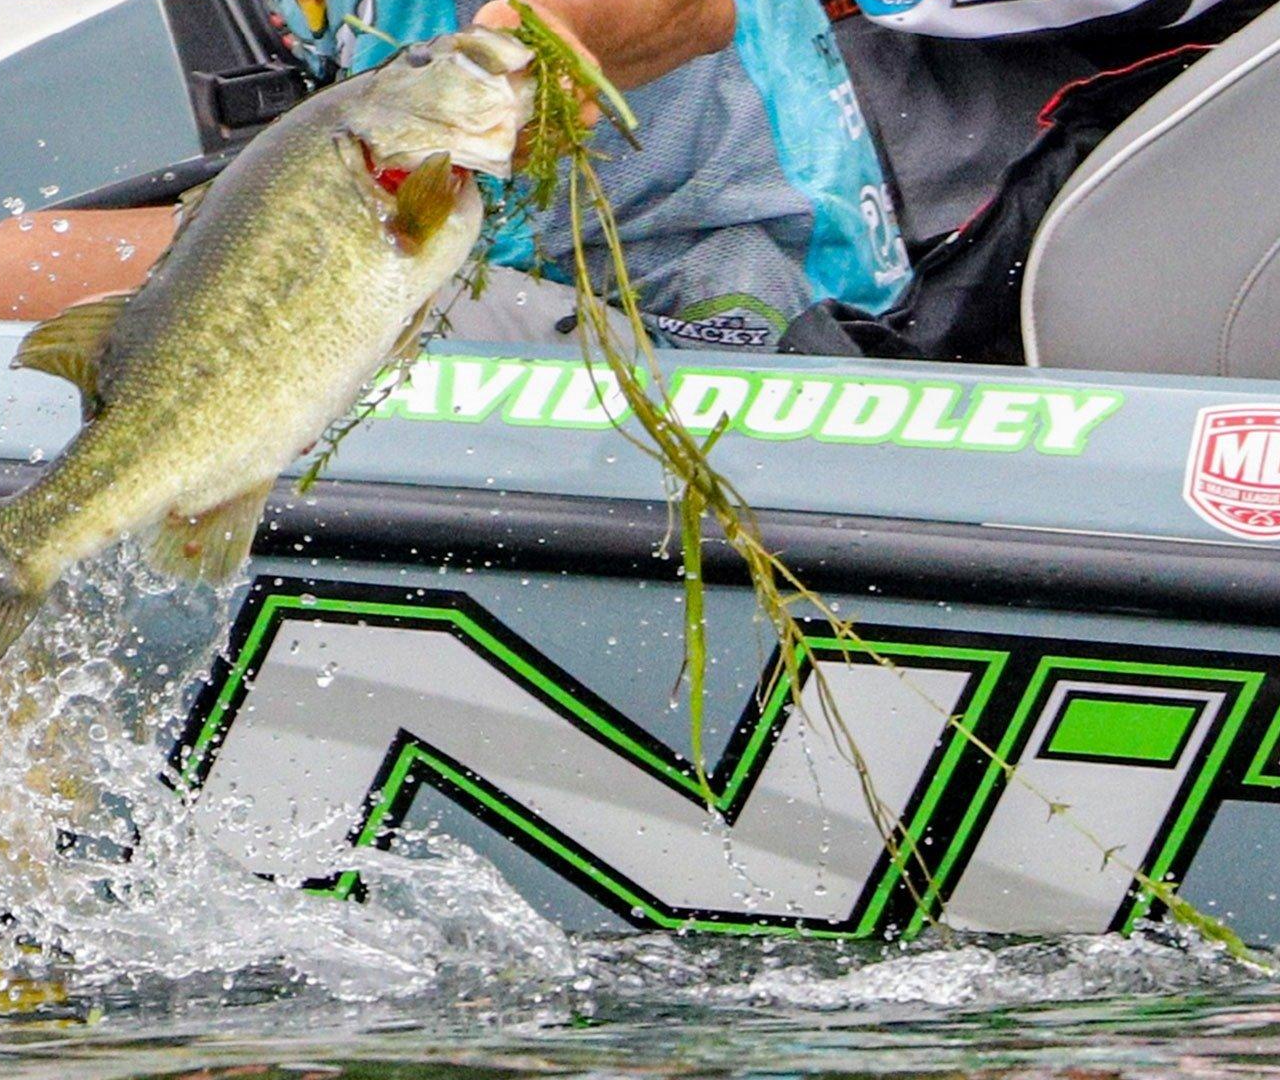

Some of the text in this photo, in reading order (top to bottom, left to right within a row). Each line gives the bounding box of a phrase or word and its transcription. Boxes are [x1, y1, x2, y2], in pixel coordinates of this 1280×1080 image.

[658, 316, 770, 346] WACKY
[360, 357, 1123, 456] AVID DUDLEY
